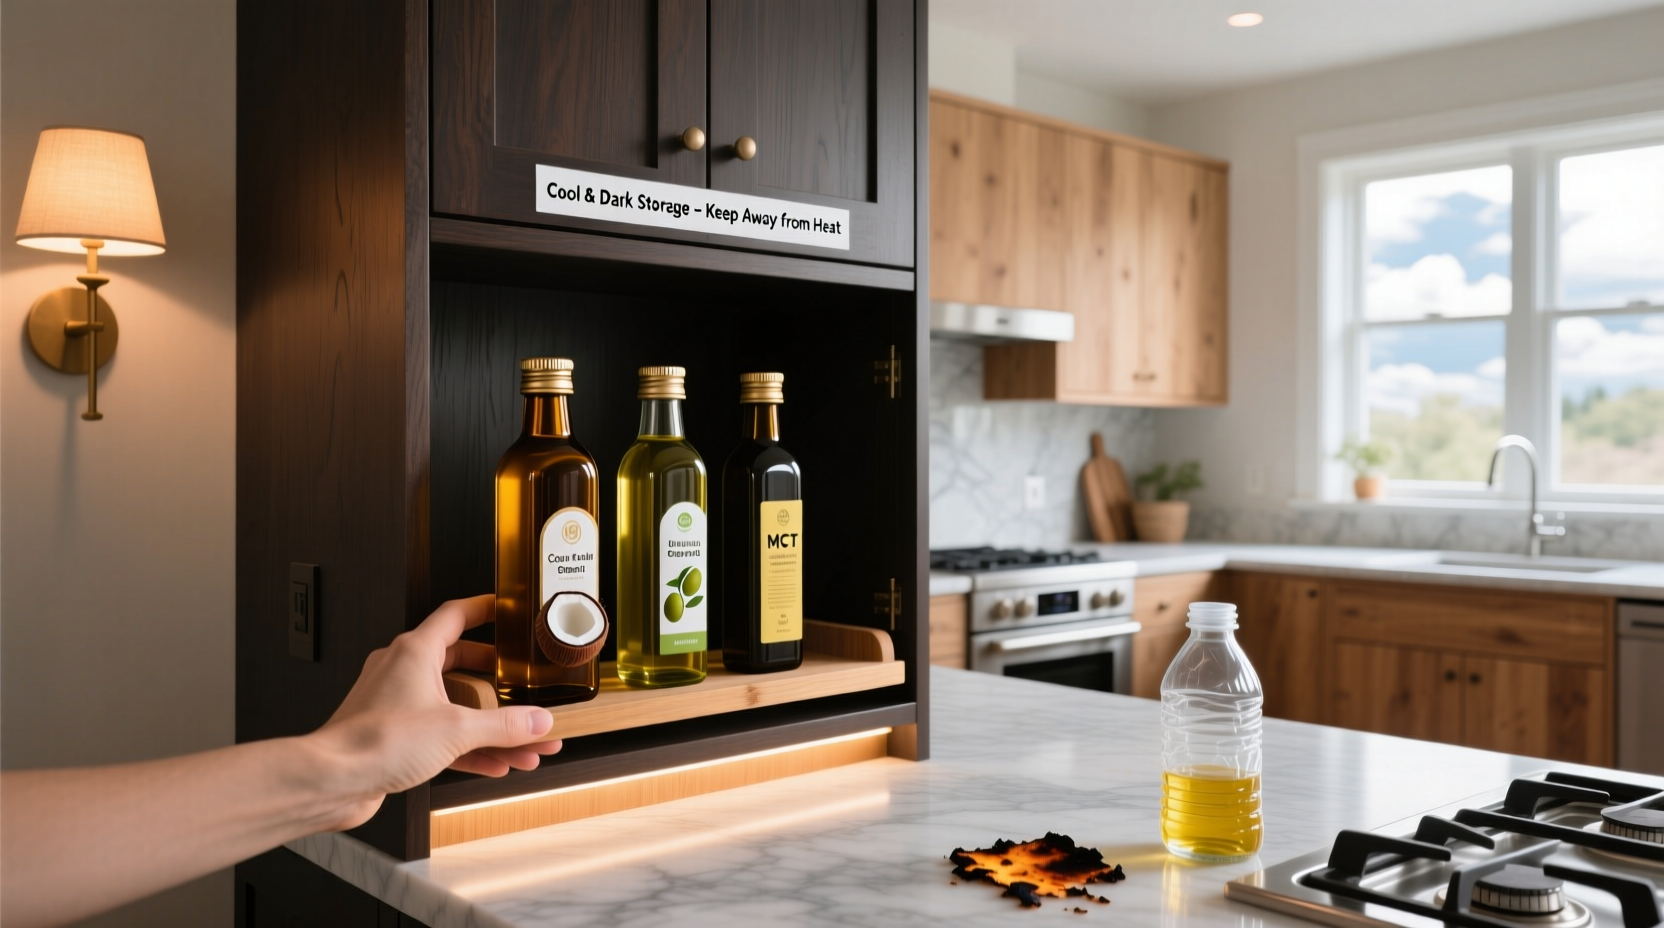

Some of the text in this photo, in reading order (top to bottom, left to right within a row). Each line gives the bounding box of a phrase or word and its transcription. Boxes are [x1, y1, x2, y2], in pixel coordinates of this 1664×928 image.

[547, 182, 580, 202] Cool
[584, 187, 595, 203] &
[600, 189, 633, 208] Dark
[637, 194, 690, 218] Storage
[706, 203, 738, 224] Keep
[742, 207, 778, 230] Away
[781, 212, 810, 231] from
[813, 217, 842, 234] Heat
[767, 533, 798, 549] MCT
